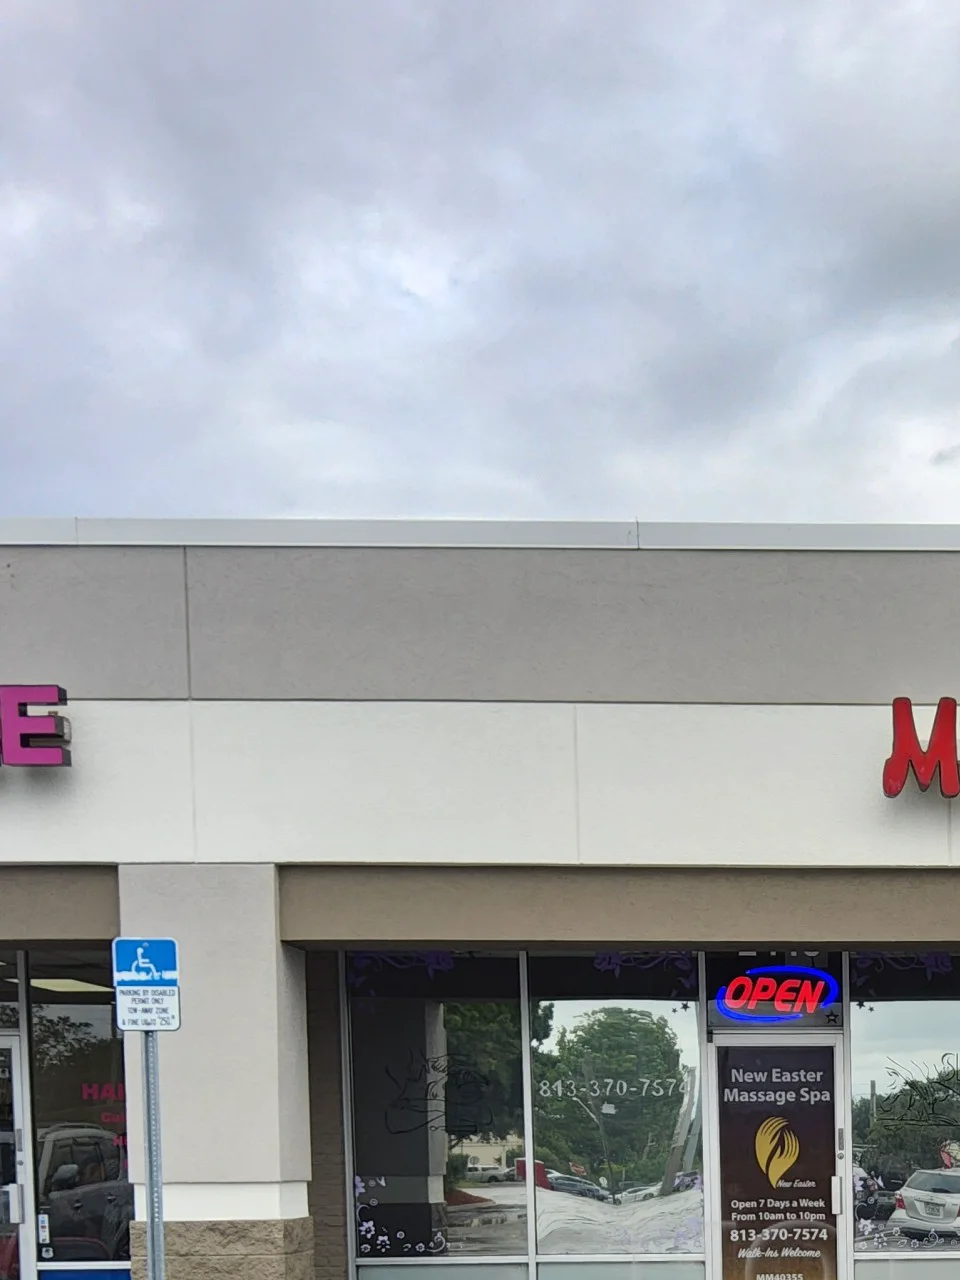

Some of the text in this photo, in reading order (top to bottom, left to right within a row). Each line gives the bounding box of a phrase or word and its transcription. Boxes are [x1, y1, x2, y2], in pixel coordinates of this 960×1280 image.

[724, 975, 825, 1013] OPEN
[731, 1068, 823, 1082] New Easter
[723, 1087, 831, 1105] Massage Spa
[731, 1198, 826, 1210] Open 7 Days a Week
[731, 1212, 826, 1222] From 10am to 10pm
[730, 1228, 828, 1241] 813-370-7574
[738, 1247, 821, 1258] Walk-Ins Welcome
